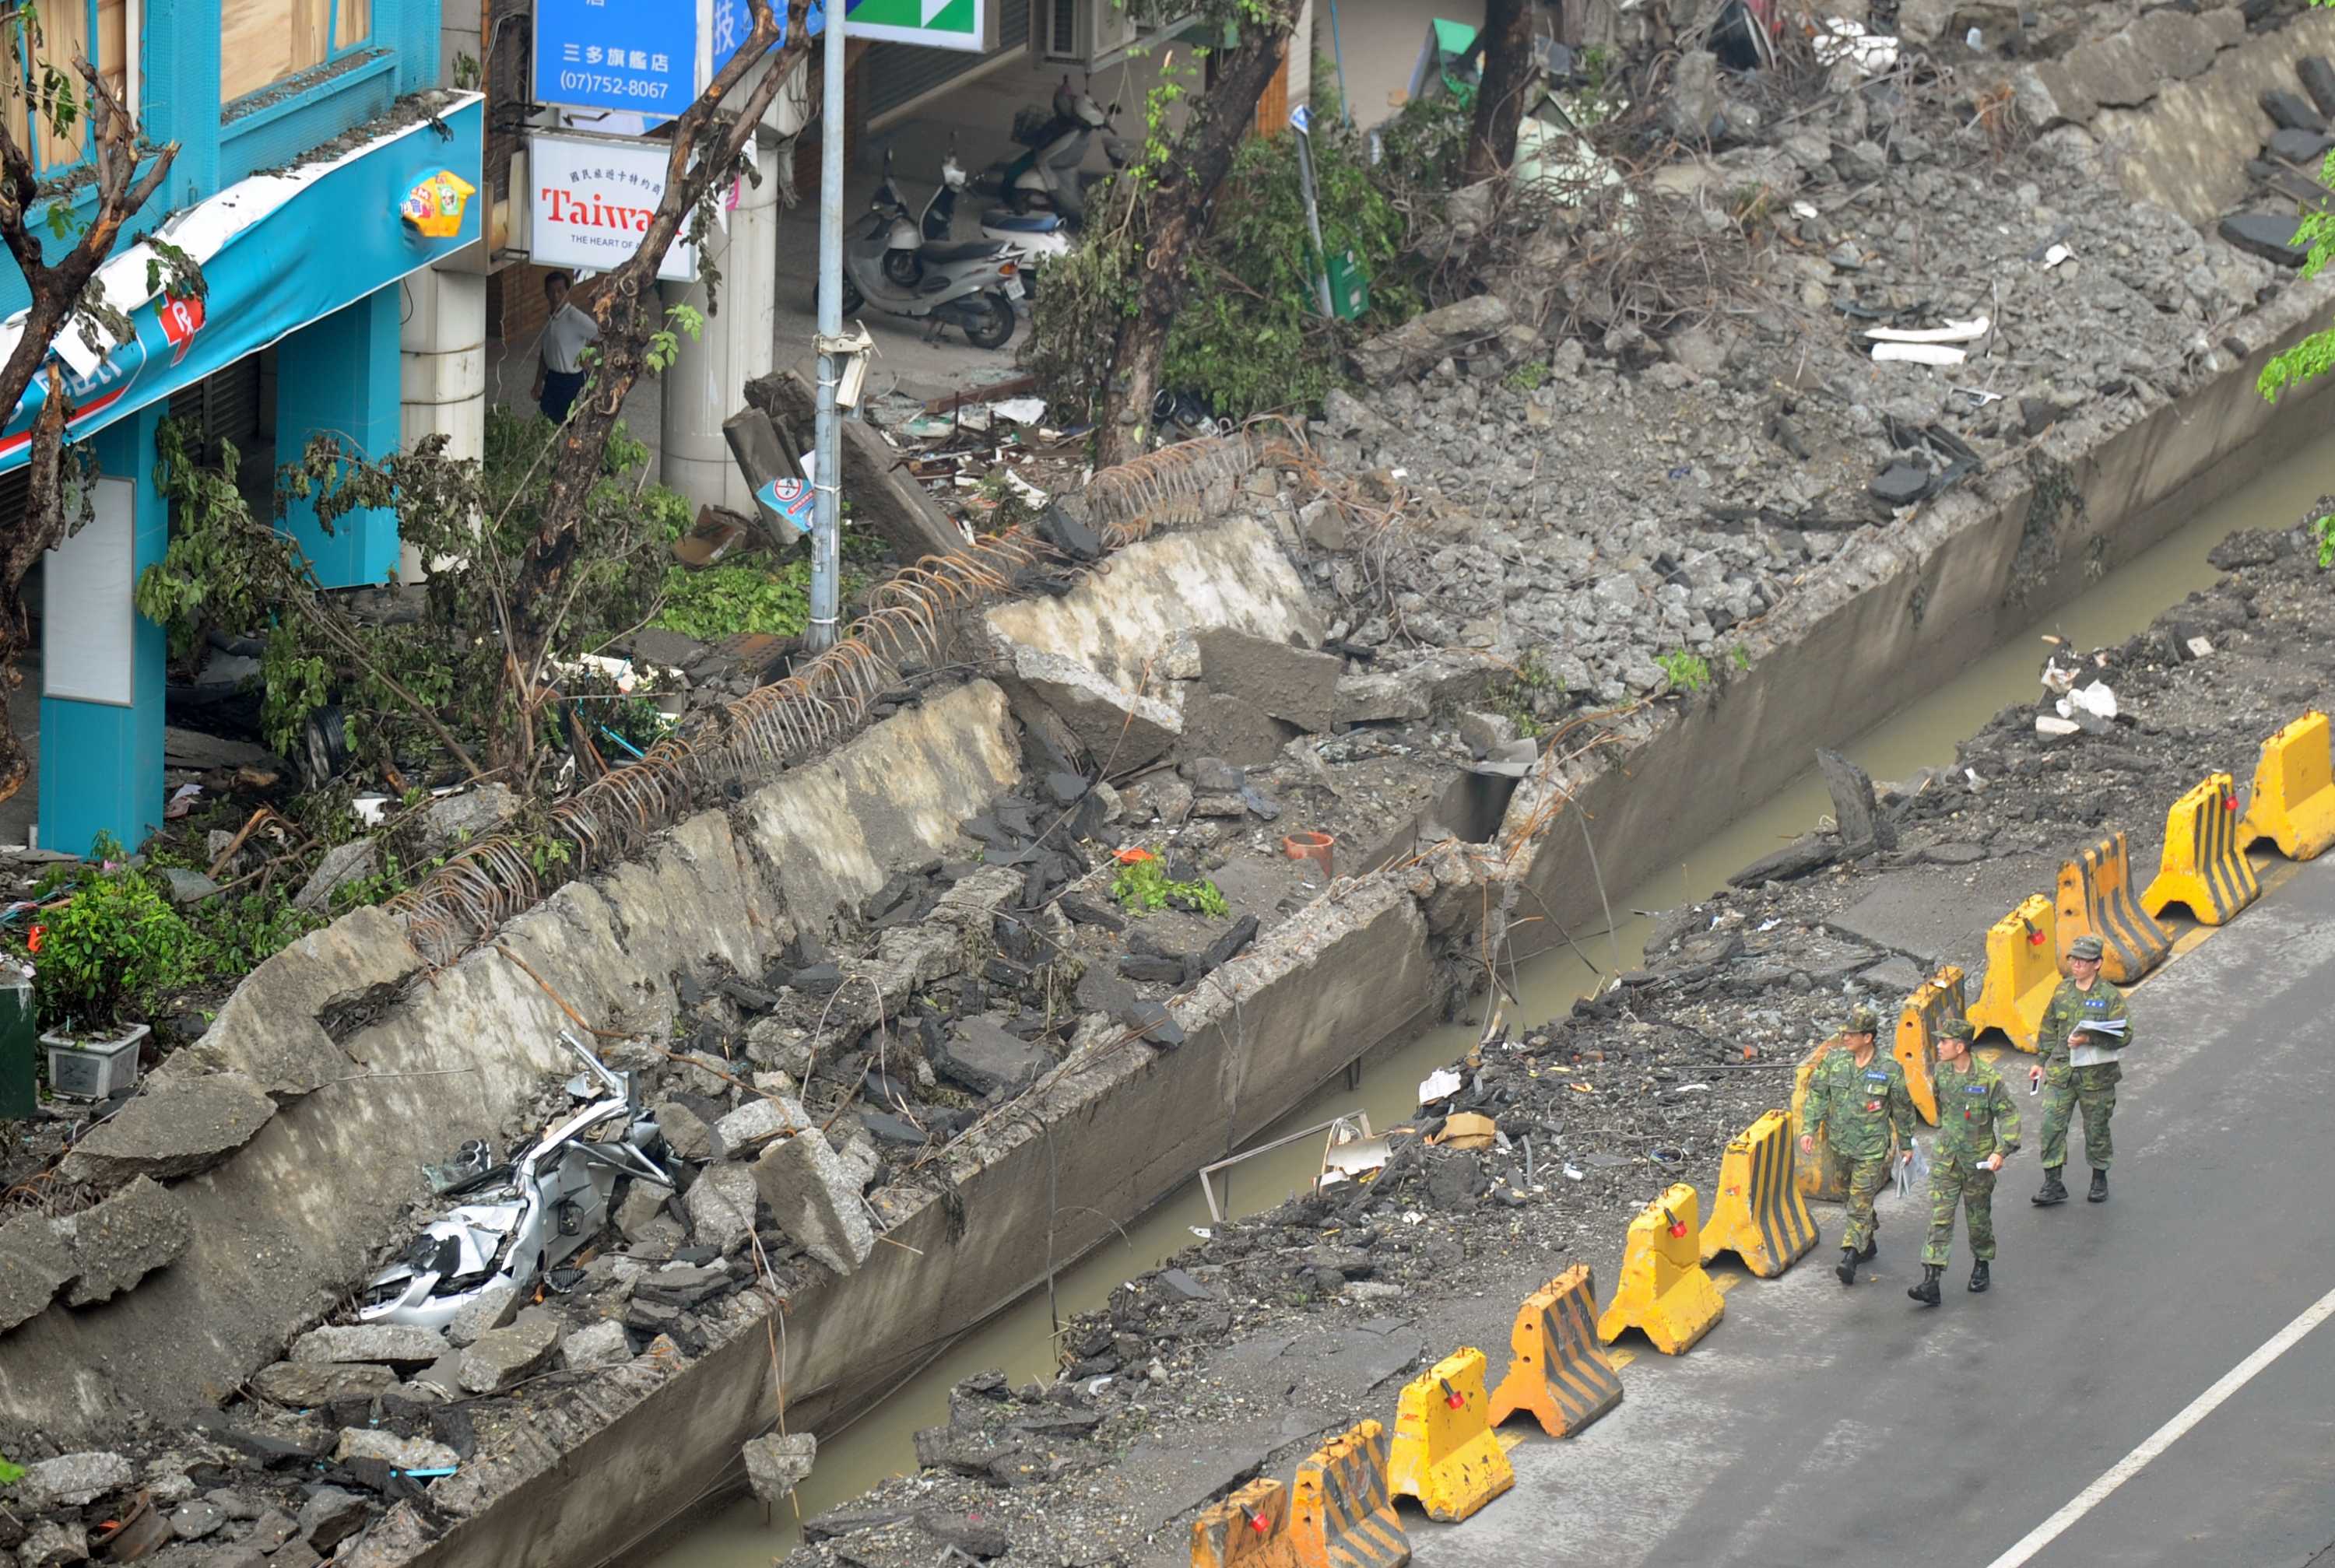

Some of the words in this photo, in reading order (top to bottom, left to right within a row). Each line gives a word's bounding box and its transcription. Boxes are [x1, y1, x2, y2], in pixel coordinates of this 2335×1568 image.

[563, 44, 669, 73] 三多旗艦店
[560, 70, 669, 100] (07)752-8067
[570, 168, 662, 195] 國民旅遊卡特約商
[542, 188, 683, 236] Taiwa
[571, 235, 588, 245] THE
[590, 237, 620, 248] HEART
[622, 240, 634, 249] OF
